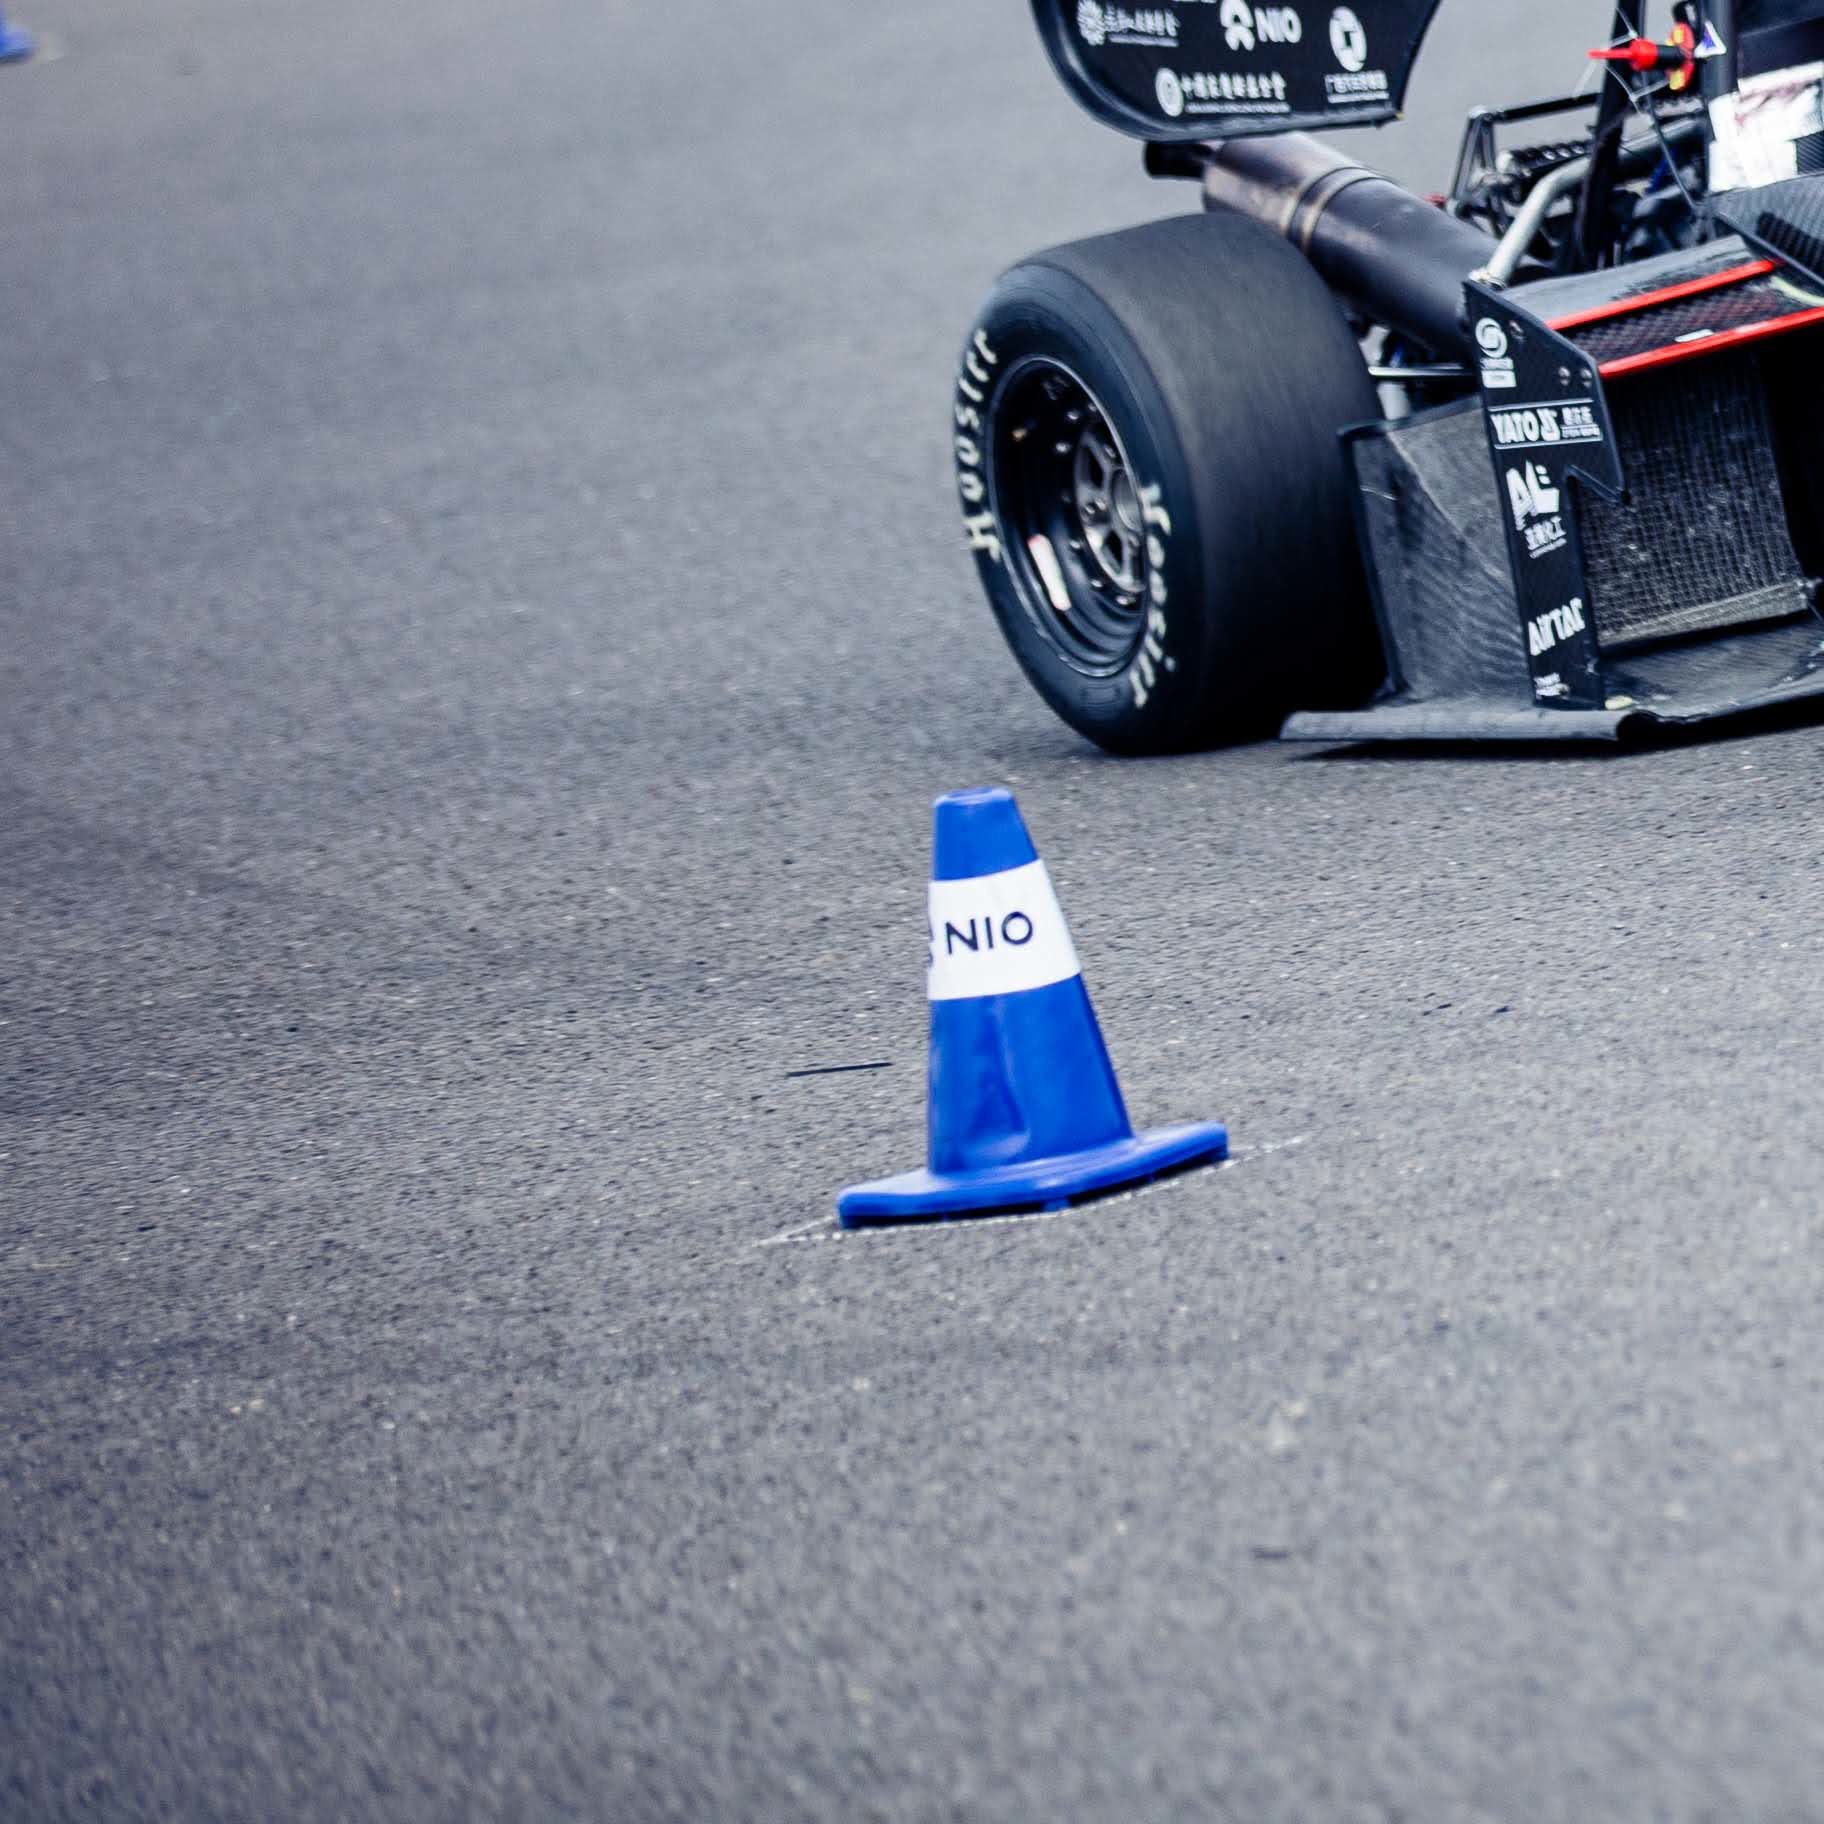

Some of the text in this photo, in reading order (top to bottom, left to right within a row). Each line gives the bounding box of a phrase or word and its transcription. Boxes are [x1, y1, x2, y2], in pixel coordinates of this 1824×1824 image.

[1253, 6, 1302, 44] NIO
[1490, 410, 1540, 444] YATO
[945, 910, 1035, 955] NIO
